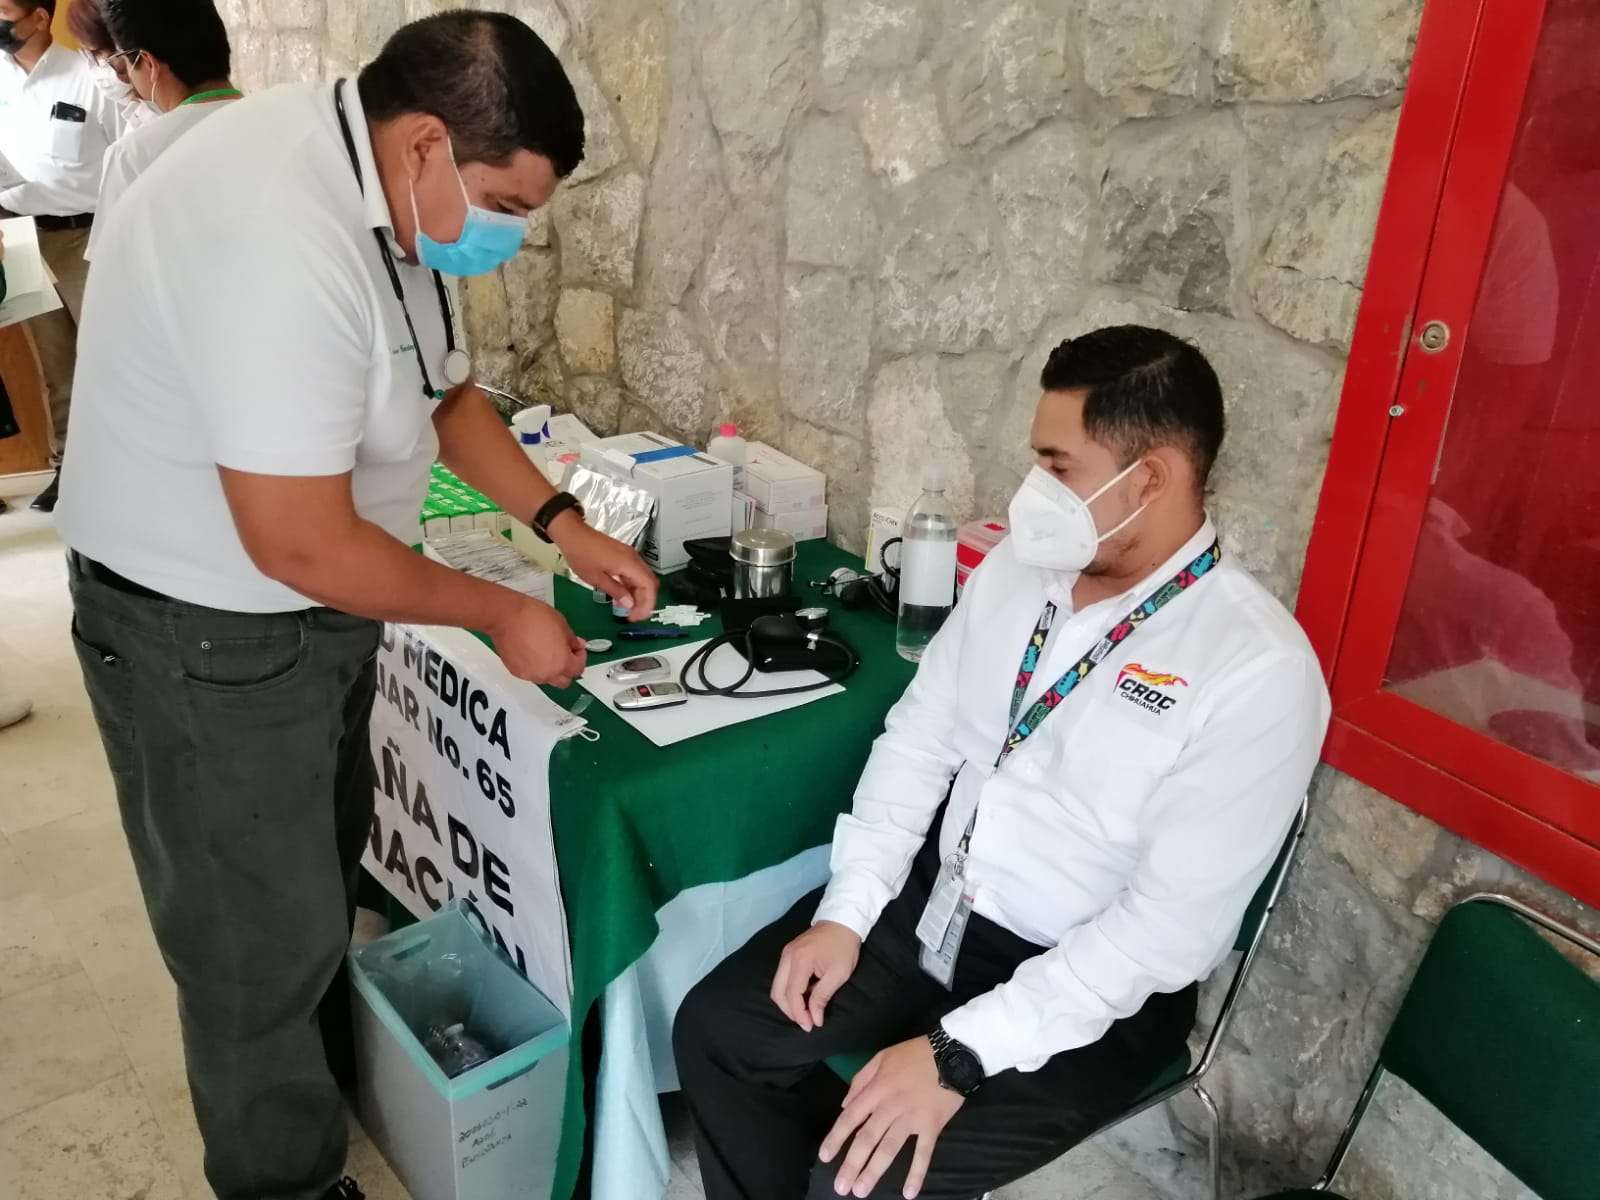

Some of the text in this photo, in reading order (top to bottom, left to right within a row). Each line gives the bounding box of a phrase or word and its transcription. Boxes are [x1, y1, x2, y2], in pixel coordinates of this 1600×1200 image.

[403, 643, 511, 761] MEDICA
[1119, 677, 1177, 711] CROC
[1119, 690, 1161, 717] CHIHUAHUA
[426, 706, 470, 780] No.
[476, 757, 516, 819] 65
[447, 811, 514, 918] DE
